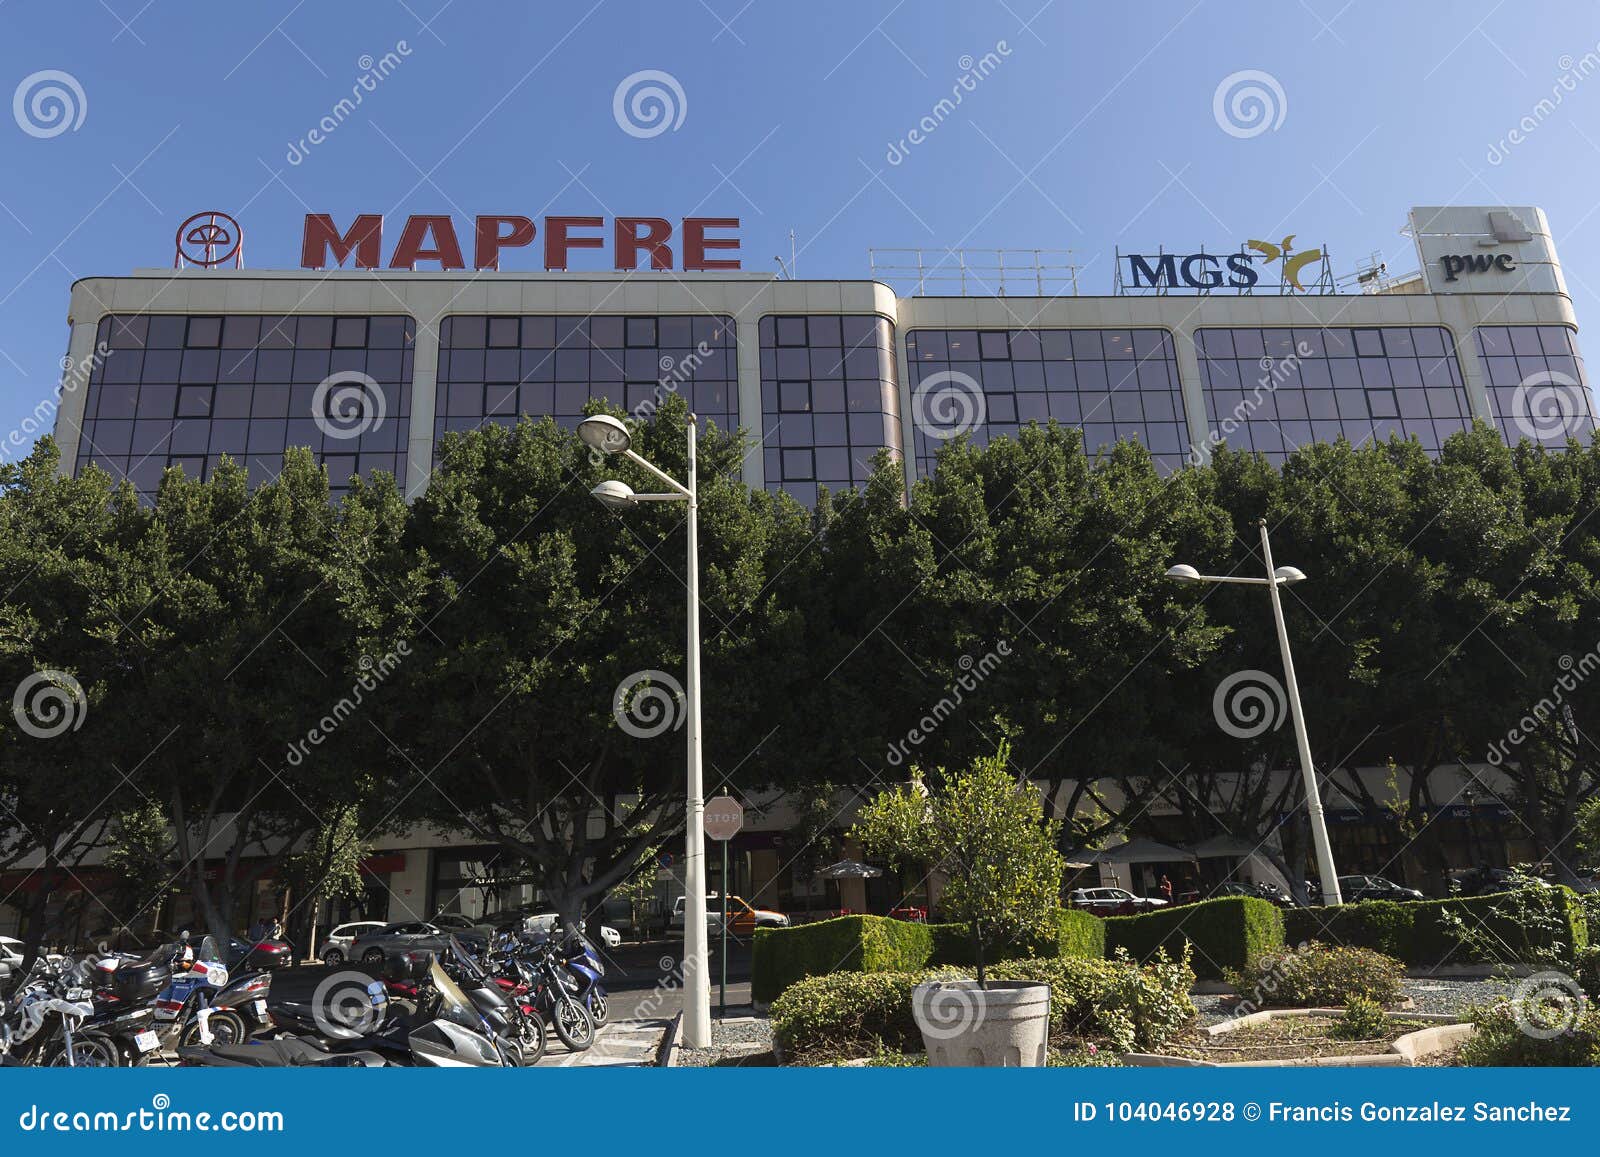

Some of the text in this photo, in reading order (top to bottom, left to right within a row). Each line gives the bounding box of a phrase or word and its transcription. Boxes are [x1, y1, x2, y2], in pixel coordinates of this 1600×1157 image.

[301, 214, 741, 269] MAPFRE
[1127, 253, 1258, 289] MGS
[1440, 250, 1517, 281] pwc
[706, 813, 739, 823] STOP
